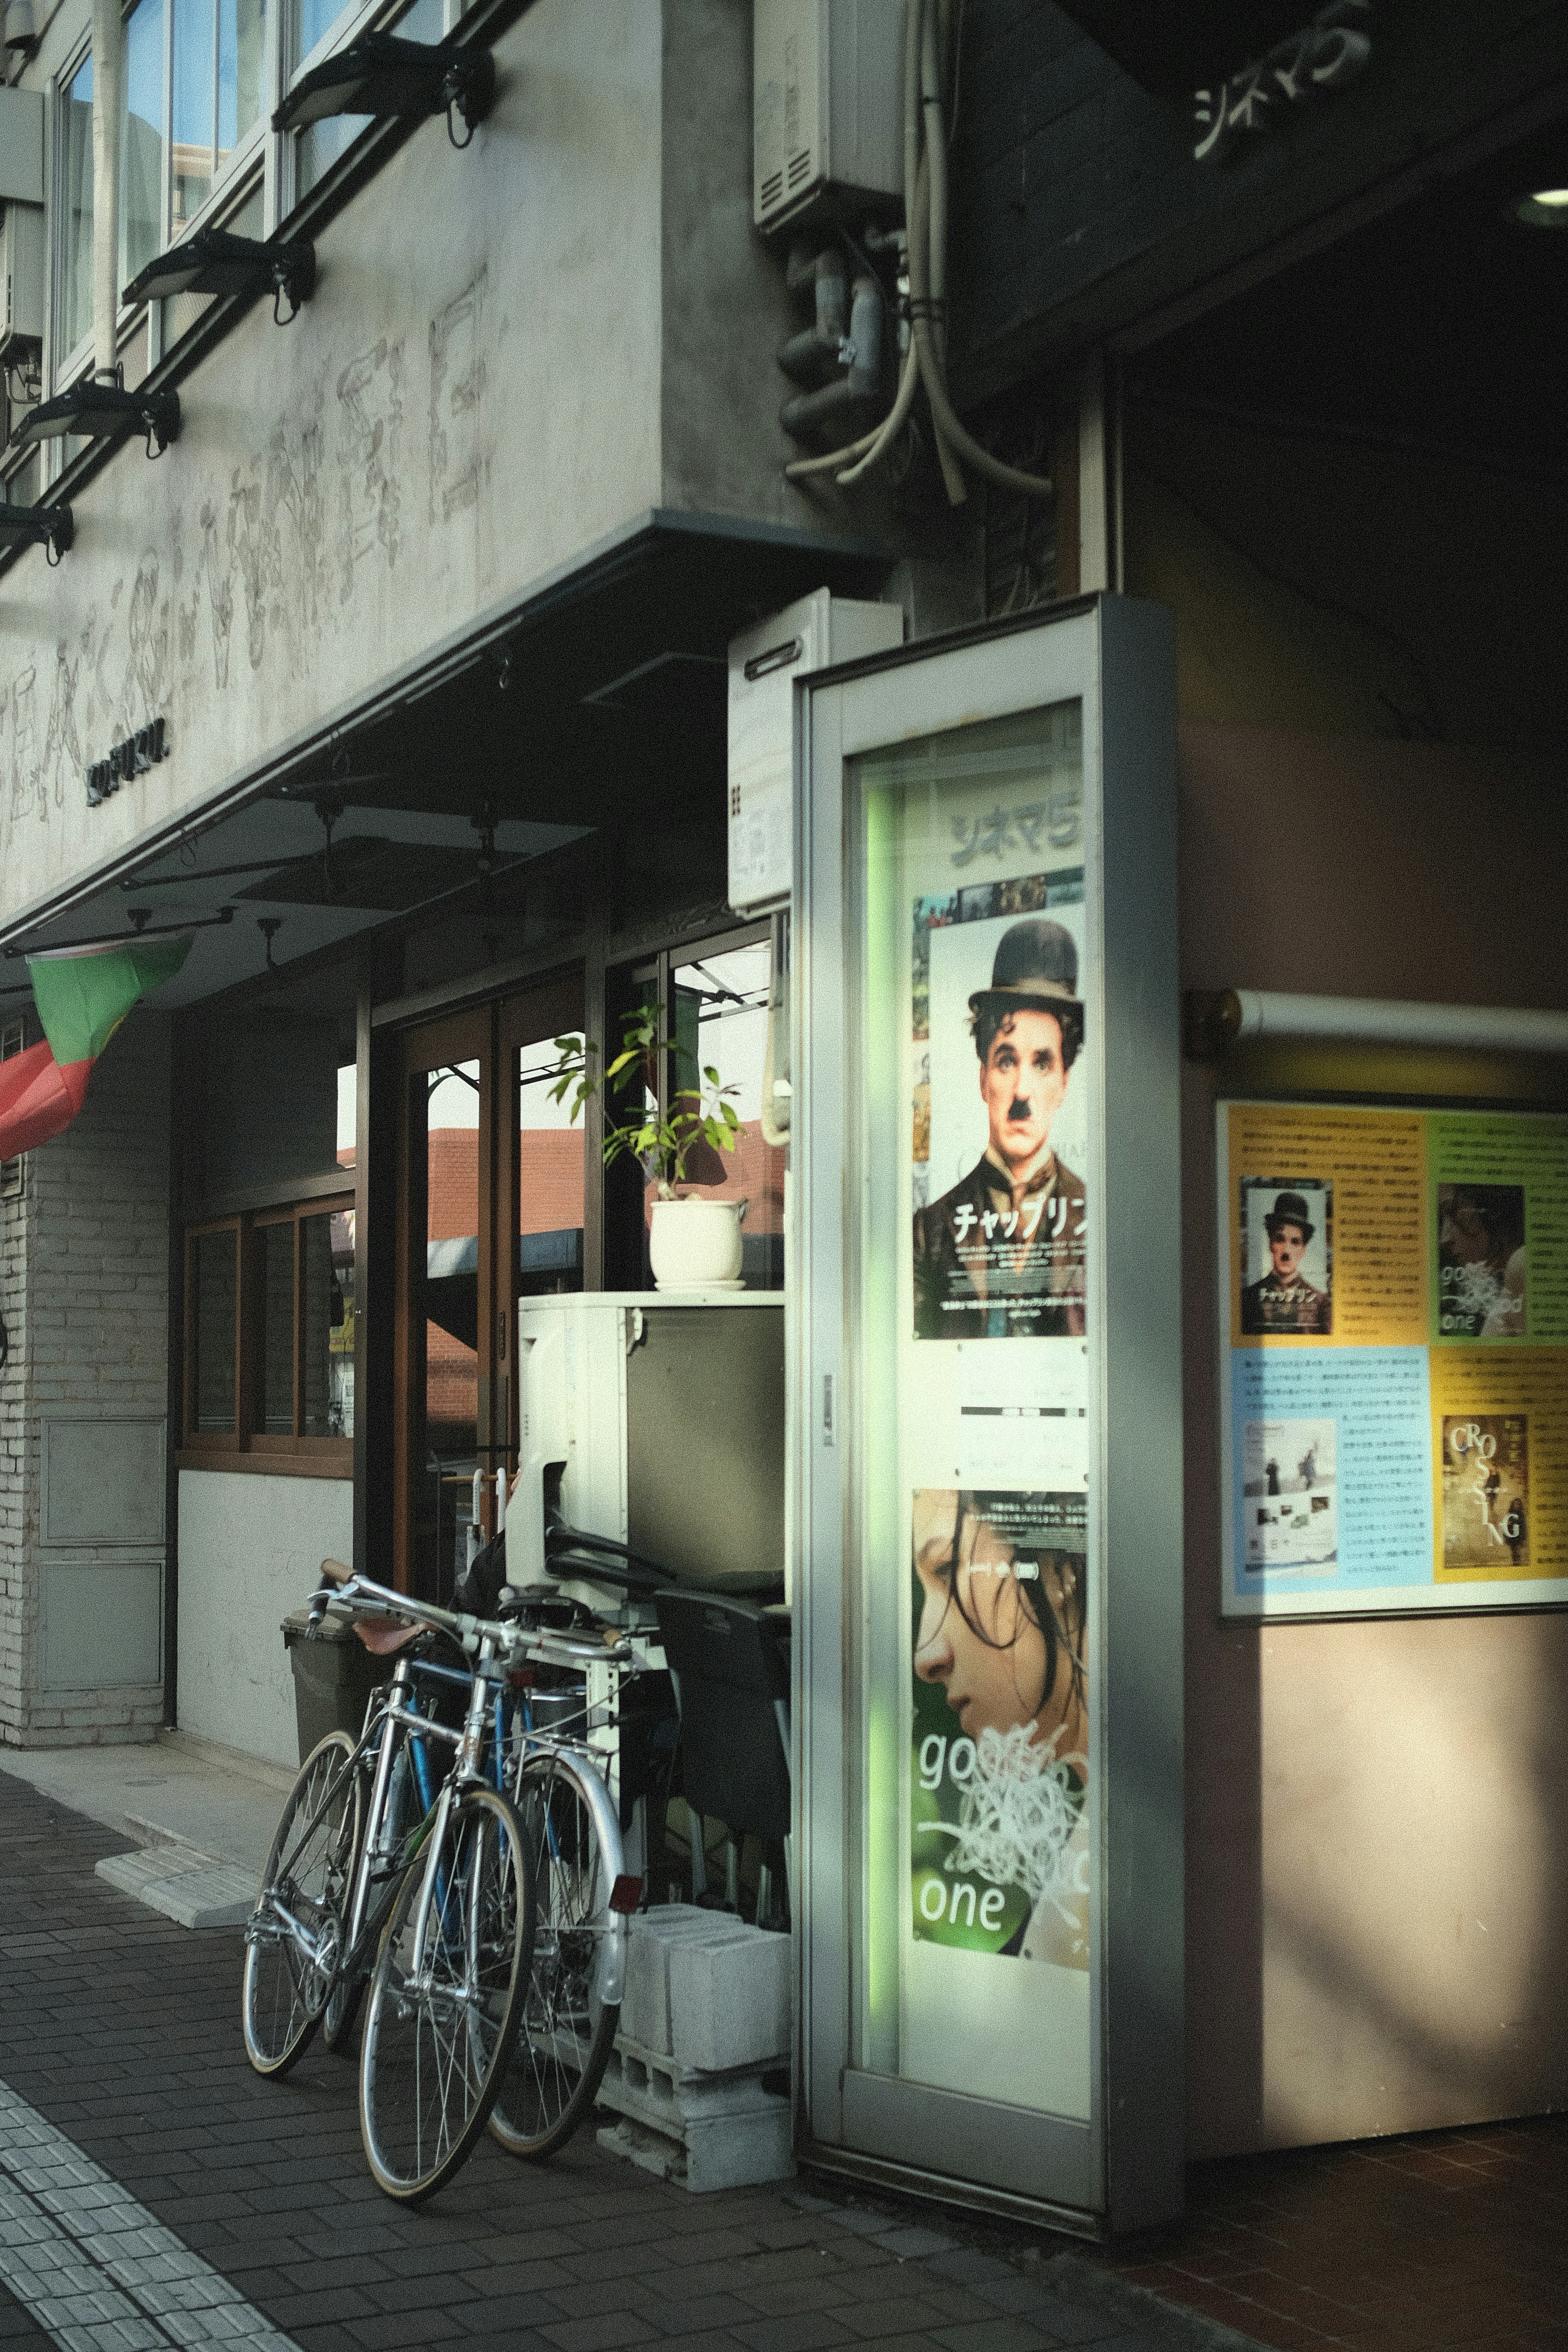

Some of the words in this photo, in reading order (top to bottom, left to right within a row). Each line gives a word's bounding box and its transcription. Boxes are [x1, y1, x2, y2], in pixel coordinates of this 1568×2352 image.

[951, 791, 1080, 867] シネマ5
[953, 1193, 1088, 1243] チャップリン
[1441, 1314, 1476, 1330] one
[1449, 1423, 1520, 1547] CROSSING
[920, 1733, 977, 1790] go
[920, 1878, 1005, 1931] one
